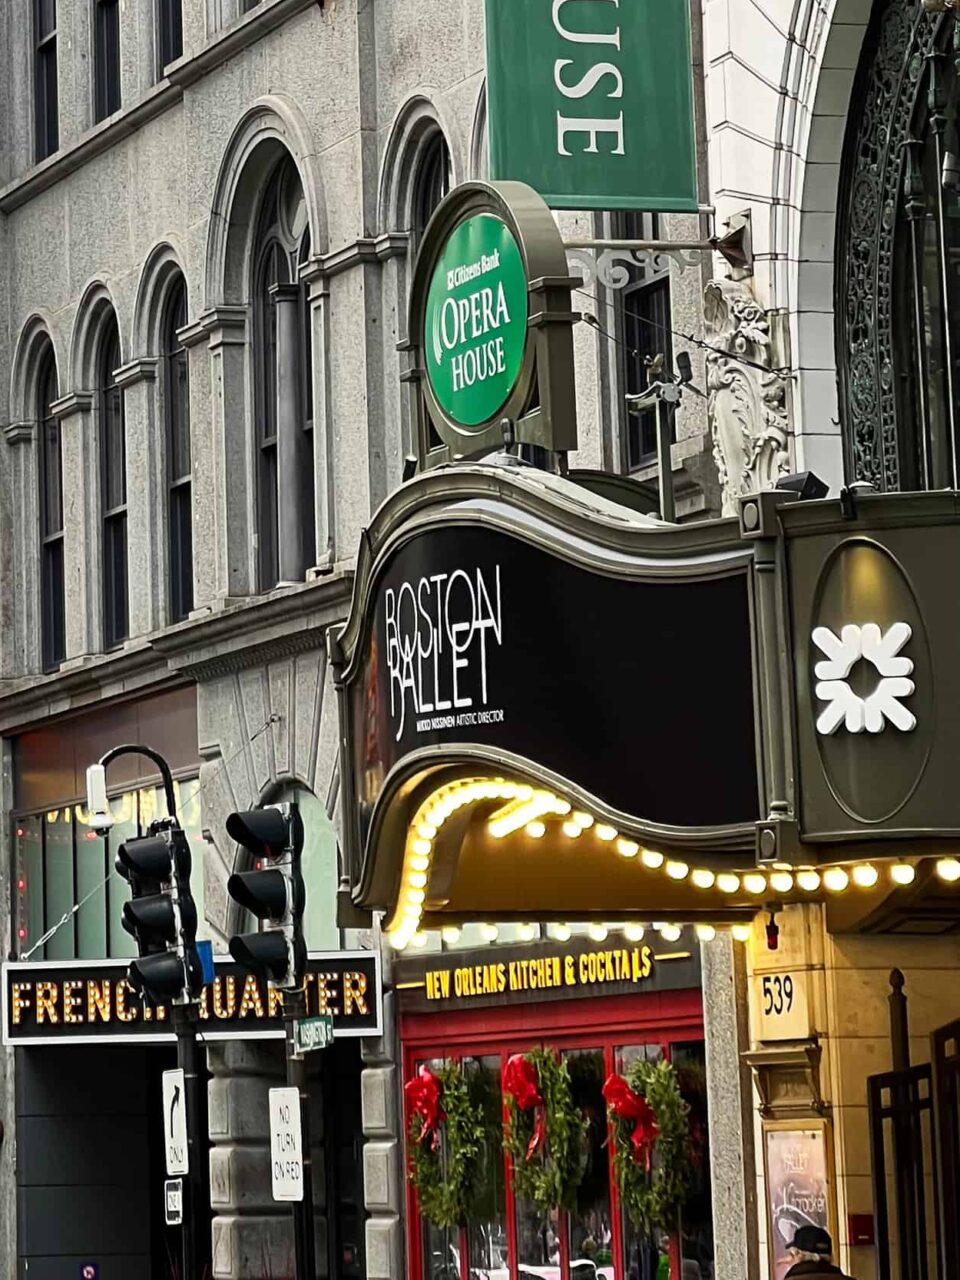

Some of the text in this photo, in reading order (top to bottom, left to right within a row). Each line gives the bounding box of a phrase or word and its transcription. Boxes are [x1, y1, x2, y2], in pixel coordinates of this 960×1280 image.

[454, 248, 500, 287] Citizens Bank
[441, 281, 511, 350] OPERA
[451, 337, 506, 392] HOUSE
[385, 564, 502, 667] BOSTON
[390, 619, 495, 742] BALLET
[12, 972, 370, 1024] FRENC UAER
[425, 970, 450, 1000] NEW
[454, 962, 506, 998] ORLEANS
[509, 956, 562, 991] KITCHEN
[564, 955, 576, 986] &
[762, 974, 793, 1016] 539
[279, 1105, 290, 1125] NO
[169, 1146, 184, 1164] ONLY
[276, 1133, 296, 1152] TURN
[275, 1161, 300, 1181] ON RED
